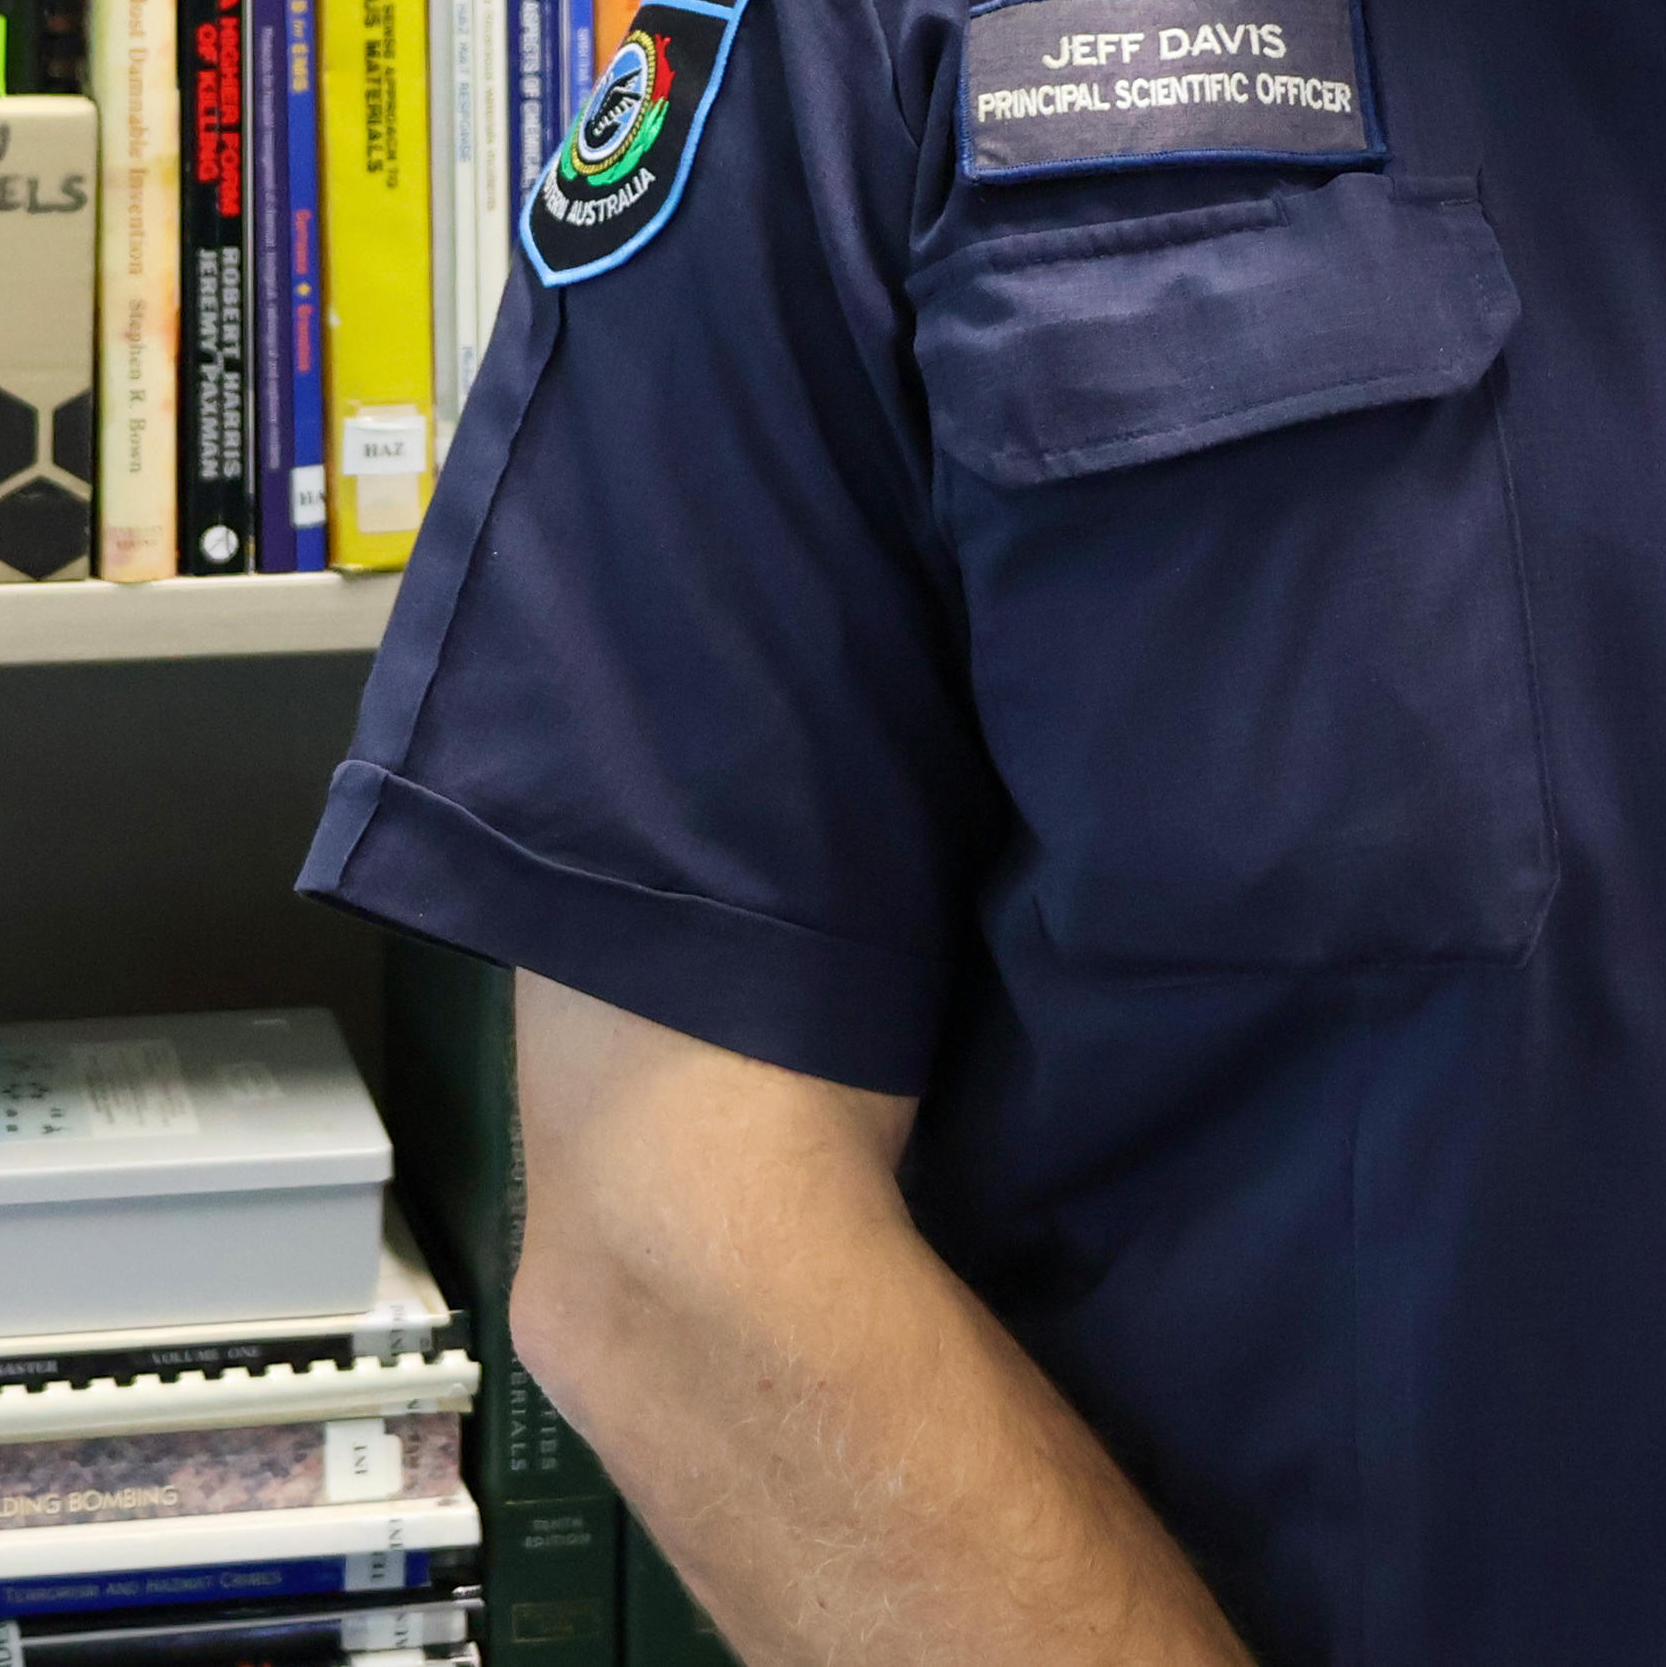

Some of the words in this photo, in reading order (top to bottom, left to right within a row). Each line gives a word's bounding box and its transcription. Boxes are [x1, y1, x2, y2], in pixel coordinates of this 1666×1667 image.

[1043, 32, 1144, 70] JEFF
[1159, 23, 1286, 61] DAVIS
[364, 40, 386, 173] MATERIALS
[978, 83, 1110, 123] PRINCIPAL
[1116, 73, 1248, 110] SCIENTIFIC
[1256, 73, 1351, 113] OFFICER
[566, 166, 656, 227] AUSTRALIA
[198, 249, 219, 348] JEREMY
[220, 248, 241, 342] ROBERT
[121, 300, 148, 379] Stephen
[128, 388, 147, 409] R.
[197, 364, 220, 479] PAXMAN
[220, 373, 244, 478] HARRIS
[127, 418, 148, 473] Bown
[68, 1484, 178, 1516] BOMBING
